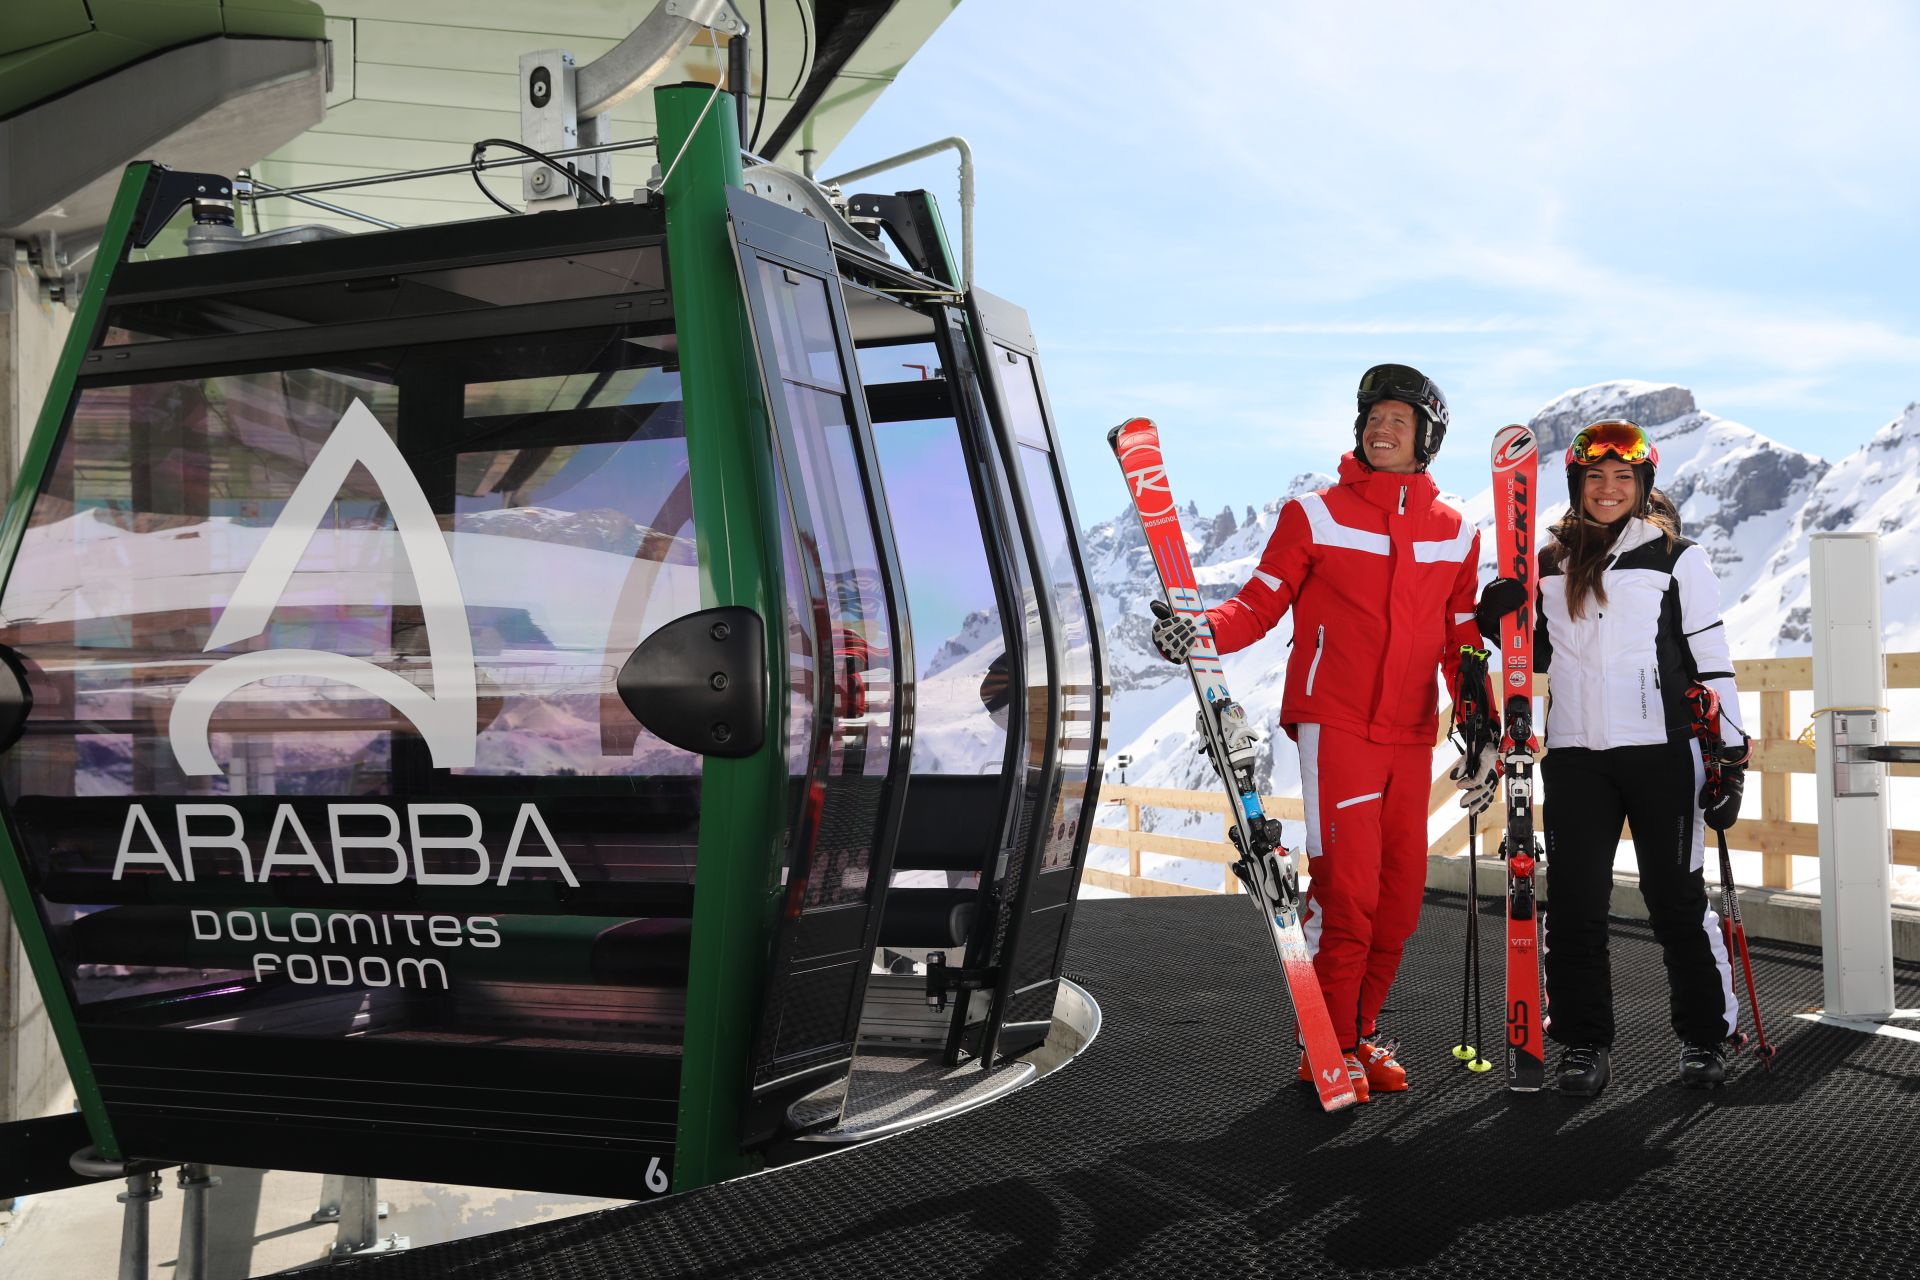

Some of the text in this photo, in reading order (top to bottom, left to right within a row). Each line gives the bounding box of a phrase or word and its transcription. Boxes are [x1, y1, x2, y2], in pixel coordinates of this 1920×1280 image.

[1144, 516, 1178, 528] ROSSIGNOL
[1513, 470, 1529, 644] SÖCKLI
[1508, 655, 1527, 665] GS
[112, 803, 580, 888] ARABBA
[1506, 1000, 1528, 1047] GS
[1509, 1047, 1517, 1079] LASER
[645, 1156, 669, 1193] 6
